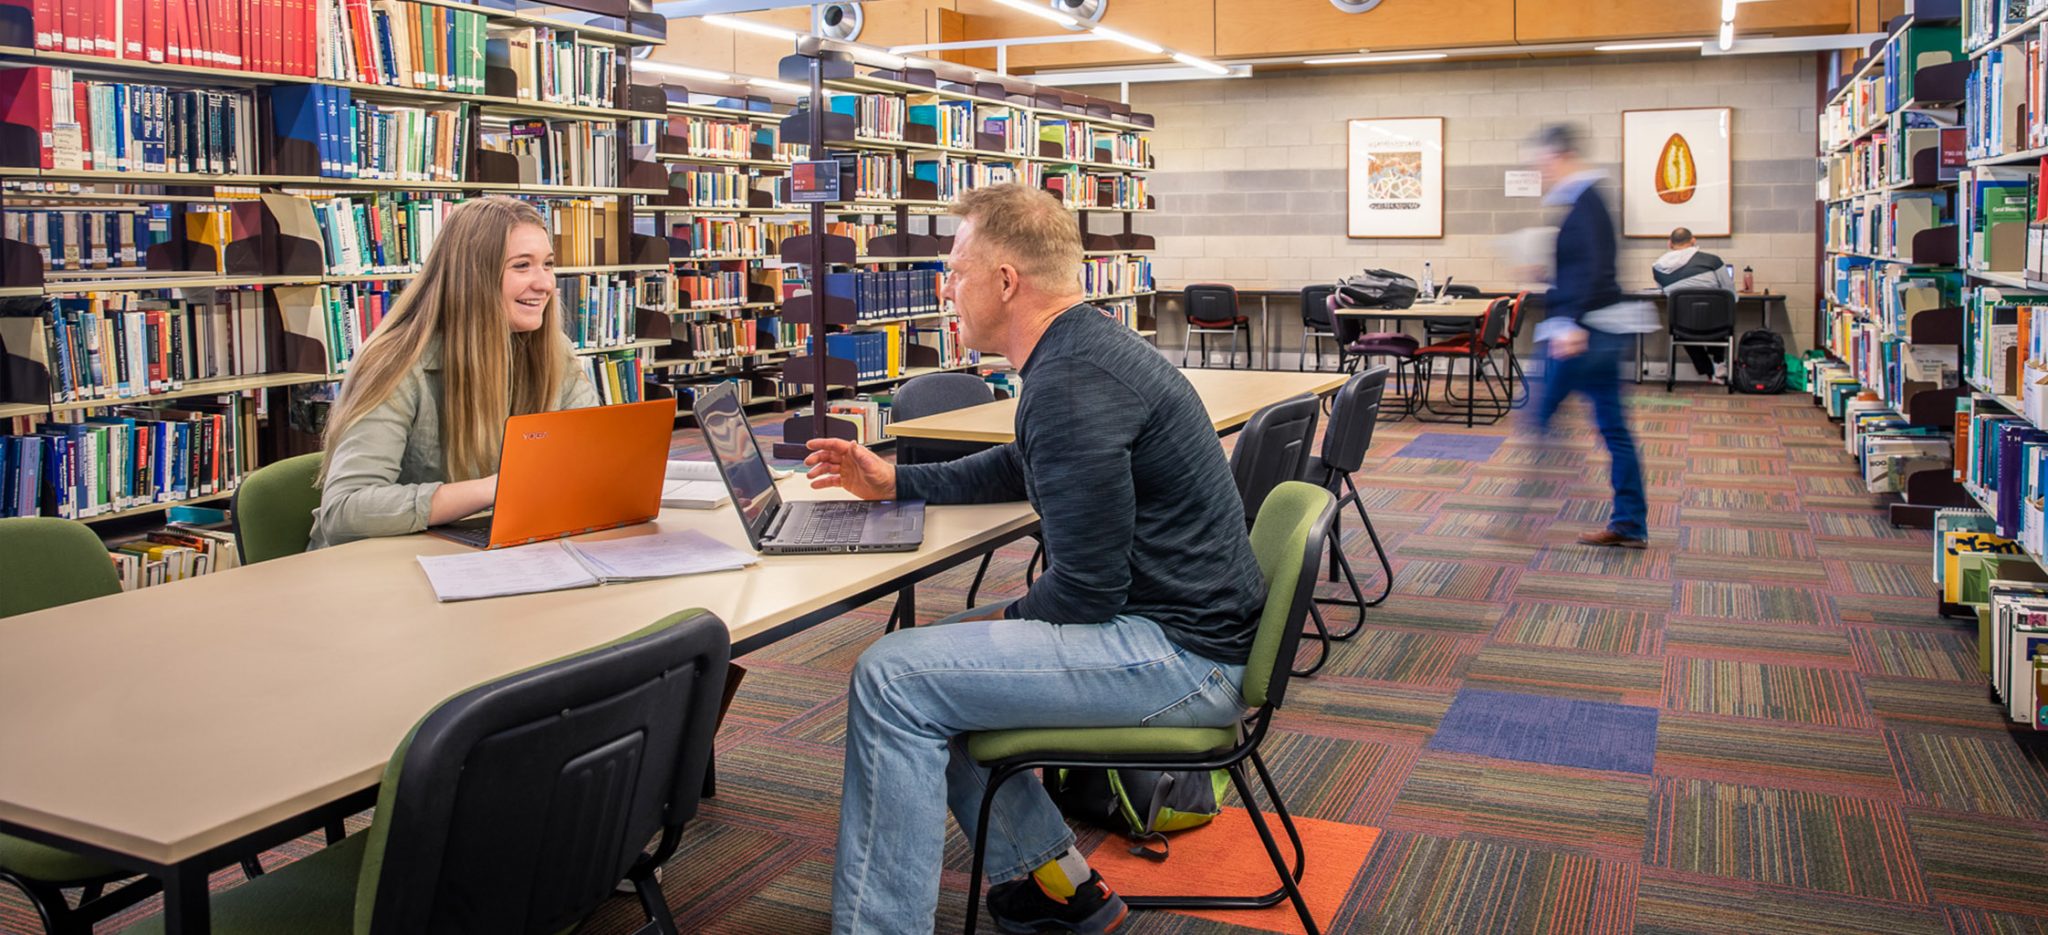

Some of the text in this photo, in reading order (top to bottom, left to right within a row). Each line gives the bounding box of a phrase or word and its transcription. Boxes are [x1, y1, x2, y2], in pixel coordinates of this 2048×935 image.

[144, 92, 152, 118] ecology
[155, 93, 163, 118] ecology
[522, 431, 548, 440] YOGA
